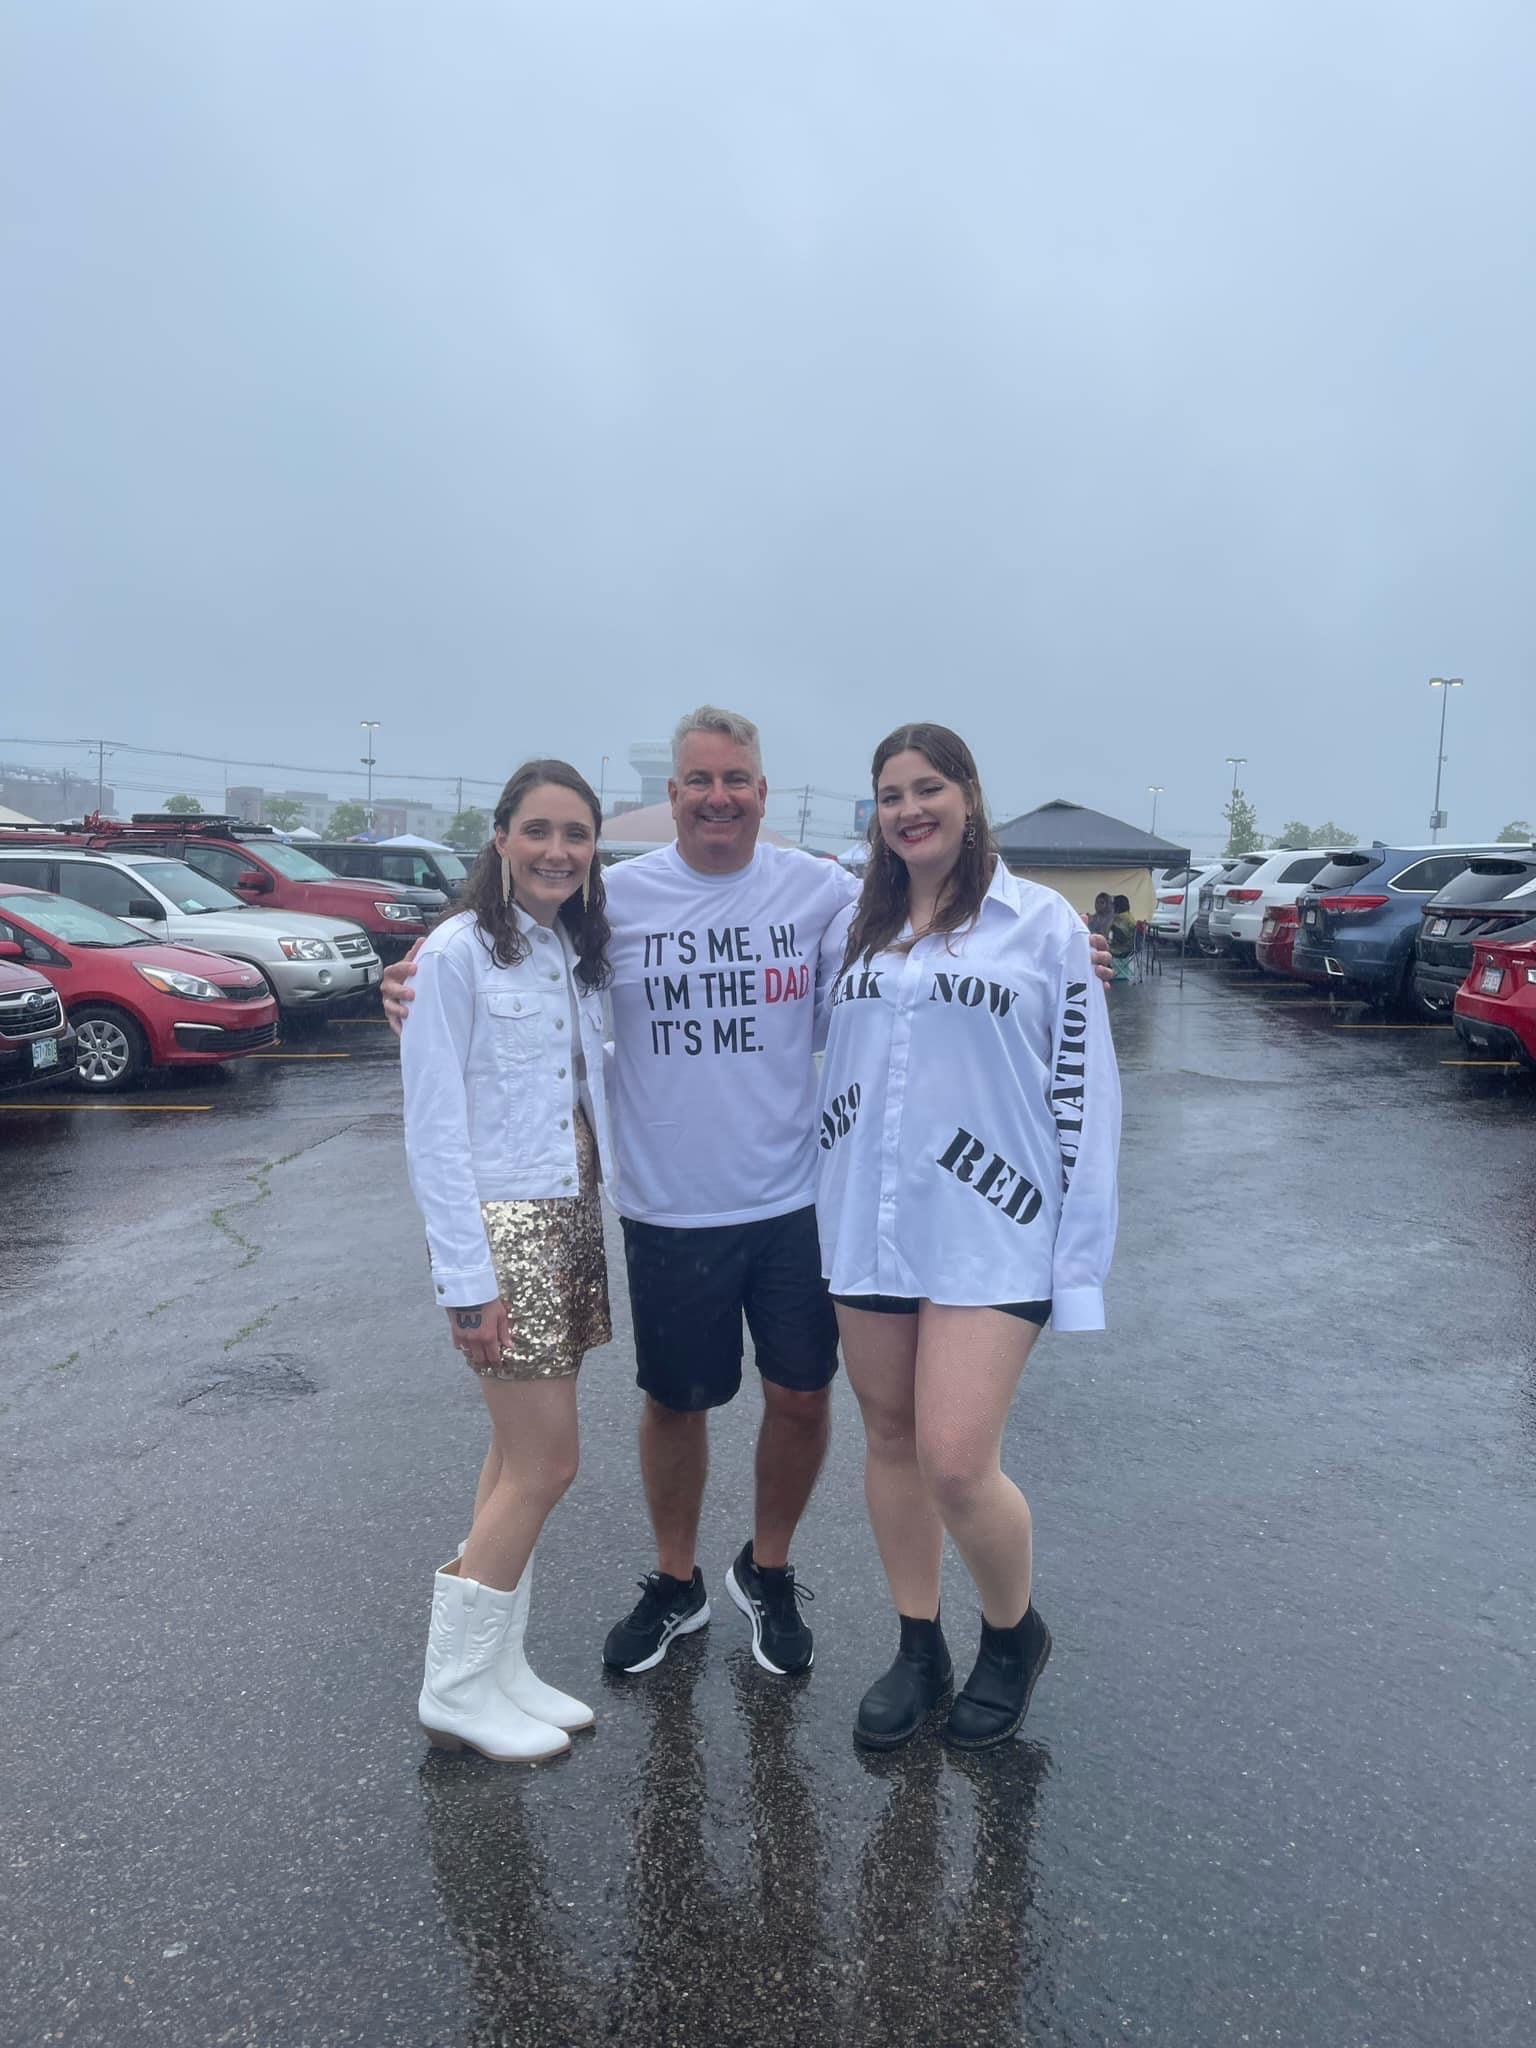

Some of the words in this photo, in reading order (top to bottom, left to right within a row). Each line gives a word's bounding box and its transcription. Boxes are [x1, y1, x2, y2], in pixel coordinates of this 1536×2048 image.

[644, 930, 697, 968] IT'S
[707, 926, 762, 963] ME,
[769, 923, 803, 958] HI.
[644, 974, 690, 1011] I'M
[699, 970, 757, 1008] THE
[765, 965, 809, 1004] DAD
[929, 972, 1019, 1016] NOW
[651, 1020, 701, 1056] IT'S
[713, 1017, 764, 1054] ME.
[1052, 981, 1088, 1194] UTATION
[936, 1127, 1043, 1225] RED
